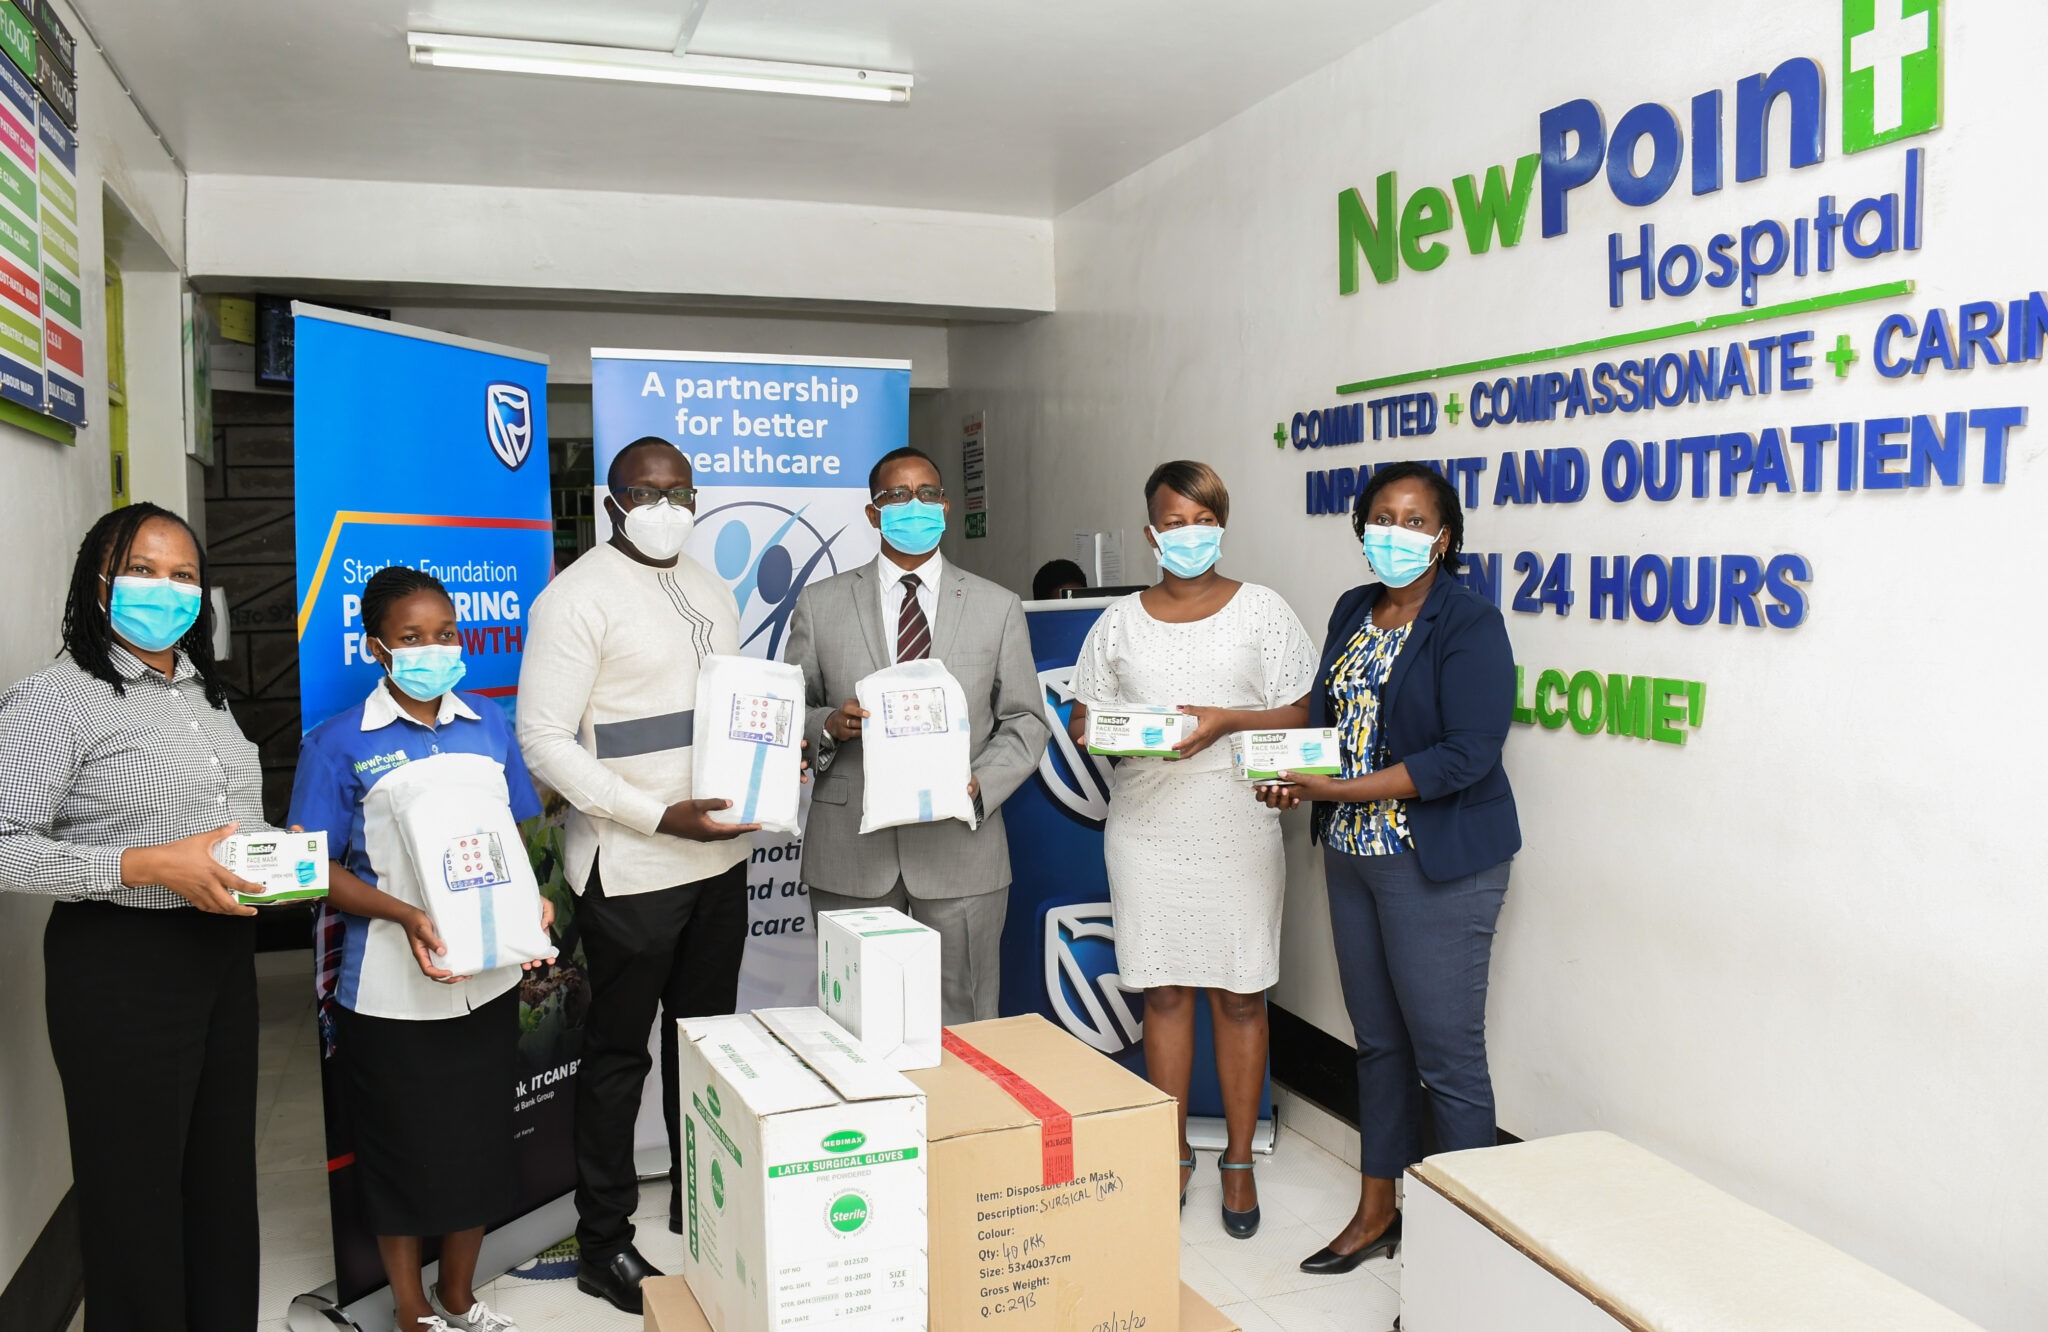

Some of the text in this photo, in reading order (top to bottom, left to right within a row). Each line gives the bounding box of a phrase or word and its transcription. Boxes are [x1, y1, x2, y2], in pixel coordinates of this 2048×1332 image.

[52, 70, 74, 116] FLOOR
[1608, 147, 1925, 308] Hospital
[641, 371, 859, 410] A partnership
[1470, 330, 1815, 428] COMPASSIONATE
[675, 408, 829, 439] for better
[1493, 446, 1590, 507] AND
[1601, 406, 2029, 502] OUTPATIENT
[419, 558, 518, 584] Foundation
[1511, 551, 1575, 616] 24
[1589, 552, 1814, 629] HOURS
[747, 877, 774, 901] nd
[531, 1074, 544, 1091] IT
[544, 1063, 569, 1086] CAN
[520, 1097, 536, 1110] Bank
[537, 1090, 555, 1103] Group
[823, 1136, 863, 1148] MEDIMAX
[777, 1150, 904, 1176] LATEX SURGICAL GLOVES
[816, 1169, 872, 1183] PRE POWDERED
[976, 1190, 1003, 1203] Item:
[1089, 1169, 1115, 1183] Mask
[687, 1128, 698, 1257] MEDIMAX
[1039, 1188, 1091, 1214] SURGICAL
[832, 1208, 867, 1223] Sterile
[977, 1203, 1039, 1222] Description:
[977, 1226, 1015, 1241] Colour:
[779, 1267, 791, 1275] LOT
[844, 1256, 869, 1266] 012520
[978, 1248, 1000, 1262] Qty:
[979, 1253, 1071, 1279] Size: 53x40x37cm
[796, 1281, 811, 1289] DATE
[844, 1272, 872, 1282] 01-2020
[889, 1269, 907, 1279] SIZE
[891, 1279, 905, 1289] 7.5
[980, 1275, 1050, 1298] Gross Weight:
[794, 1315, 809, 1323] DATE
[845, 1304, 872, 1315] 12-2024
[796, 1298, 812, 1306] DATE
[980, 1302, 1006, 1318] Q. C:
